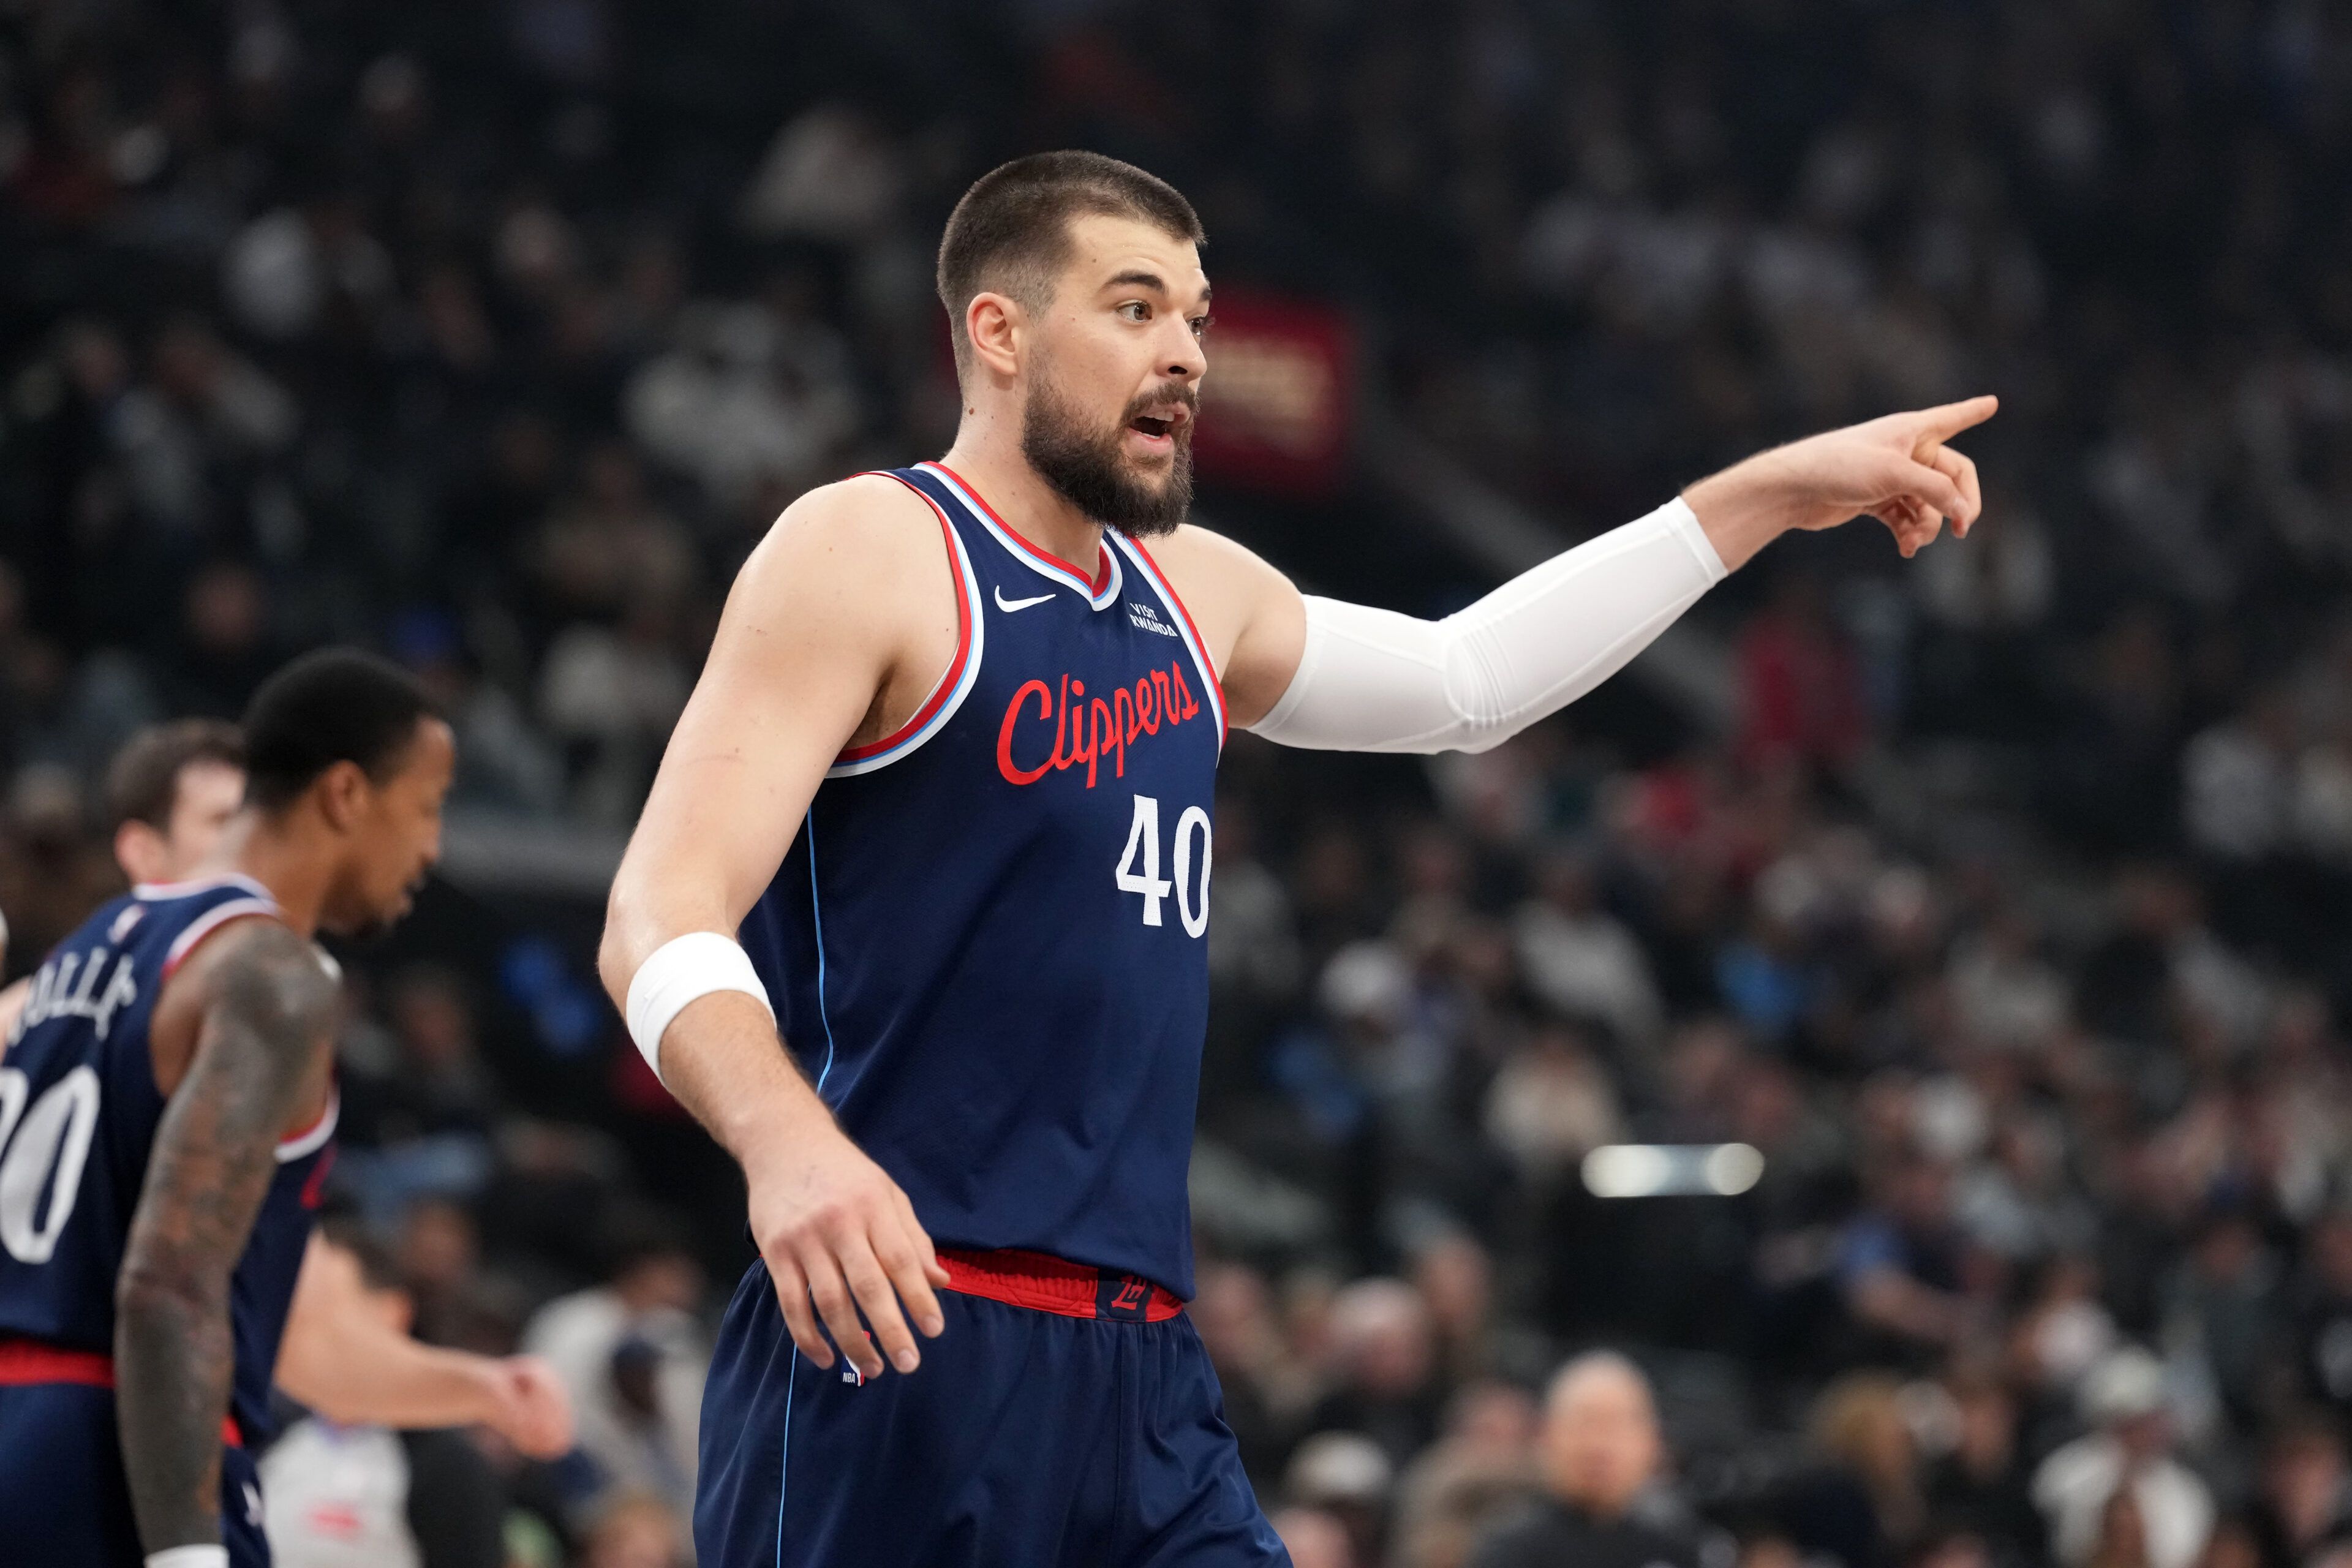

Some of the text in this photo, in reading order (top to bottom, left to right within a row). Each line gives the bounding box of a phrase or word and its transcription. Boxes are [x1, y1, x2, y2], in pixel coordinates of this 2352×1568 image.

[1129, 603, 1158, 622] VISIT
[1129, 614, 1178, 637] RWANDA
[997, 660, 1199, 789] Clippers
[1115, 794, 1212, 938] 40
[843, 1372, 856, 1384] NBA
